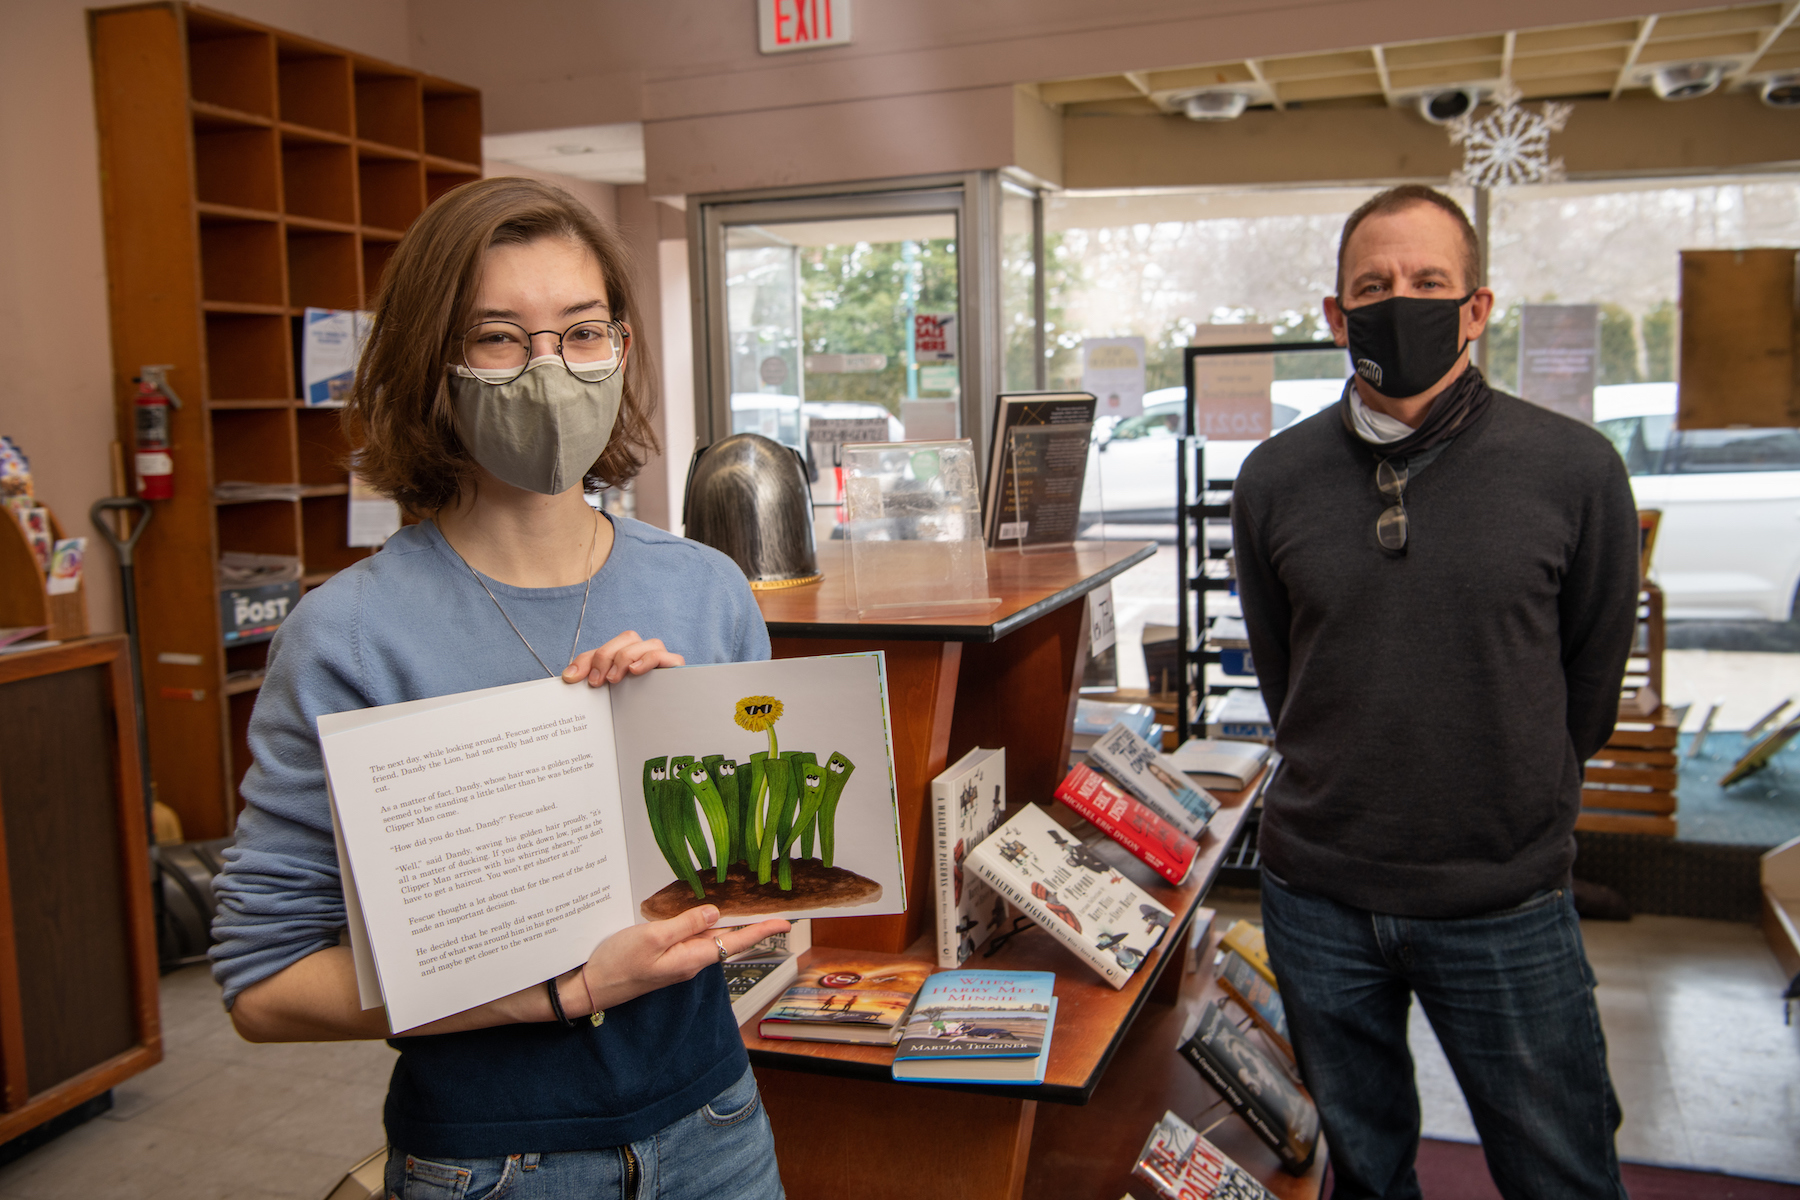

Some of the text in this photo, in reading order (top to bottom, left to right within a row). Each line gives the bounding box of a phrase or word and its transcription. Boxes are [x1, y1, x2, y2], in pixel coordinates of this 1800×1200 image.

[774, 0, 832, 45] EXIT
[914, 315, 938, 326] ON
[914, 327, 945, 339] SALE
[914, 340, 946, 352] HERE
[235, 597, 290, 625] POST
[368, 764, 386, 773] The
[386, 759, 405, 769] next
[422, 748, 444, 759] while
[445, 742, 474, 754] looking
[504, 728, 530, 739] Fescue
[531, 719, 558, 732] noticed
[558, 717, 574, 726] that
[574, 714, 586, 722] his
[400, 763, 426, 776] Dandy
[428, 760, 441, 769] the
[464, 749, 480, 760] had
[481, 747, 494, 755] not
[496, 740, 518, 752] really
[519, 735, 534, 746] had
[535, 733, 549, 742] any
[550, 729, 558, 738] of
[559, 727, 571, 736] his
[572, 723, 588, 732] hair
[380, 805, 392, 814] As
[399, 796, 427, 808] matter
[427, 791, 436, 801] of
[483, 775, 507, 786] whose
[507, 770, 524, 780] hair
[524, 766, 540, 775] was
[547, 759, 570, 771] golden
[382, 808, 412, 823] seemed
[434, 795, 469, 810] standing
[475, 788, 495, 798] little
[495, 783, 517, 793] taller
[517, 778, 536, 787] than
[547, 771, 562, 779] was
[561, 765, 583, 776] before
[583, 761, 594, 770] the
[385, 820, 415, 833] Clipper
[415, 815, 435, 825] Man
[413, 837, 427, 847] did
[428, 834, 443, 845] you
[444, 830, 455, 839] do
[508, 809, 534, 821] Fescue
[937, 804, 946, 836] WEALTH
[1060, 791, 1096, 820] MICHAEL
[1094, 816, 1115, 834] ERIC
[1112, 829, 1140, 852] DYSON
[938, 839, 947, 849] OF
[939, 852, 948, 887] PIGEONS
[1042, 863, 1072, 891] Wealth
[1063, 872, 1095, 900] Pigeons
[408, 912, 435, 925] Fescue
[437, 902, 467, 917] thought
[475, 897, 486, 905] lot
[488, 890, 509, 902] about
[510, 884, 526, 895] that
[526, 881, 537, 890] for
[538, 877, 550, 886] the
[551, 872, 565, 882] rest
[565, 867, 573, 876] of
[573, 865, 584, 874] the
[584, 861, 596, 870] day
[596, 854, 607, 865] and
[977, 863, 985, 873] A
[983, 869, 1015, 896] WEALTH
[1012, 891, 1025, 904] OF
[1023, 901, 1057, 930] PIGEONS
[411, 924, 432, 936] made
[434, 921, 445, 929] an
[445, 908, 485, 925] important
[420, 965, 436, 977] and
[437, 959, 463, 972] maybe
[464, 954, 477, 964] get
[477, 946, 499, 959] closer
[509, 939, 522, 948] the
[522, 931, 543, 943] warm
[1139, 1140, 1188, 1187] THE
